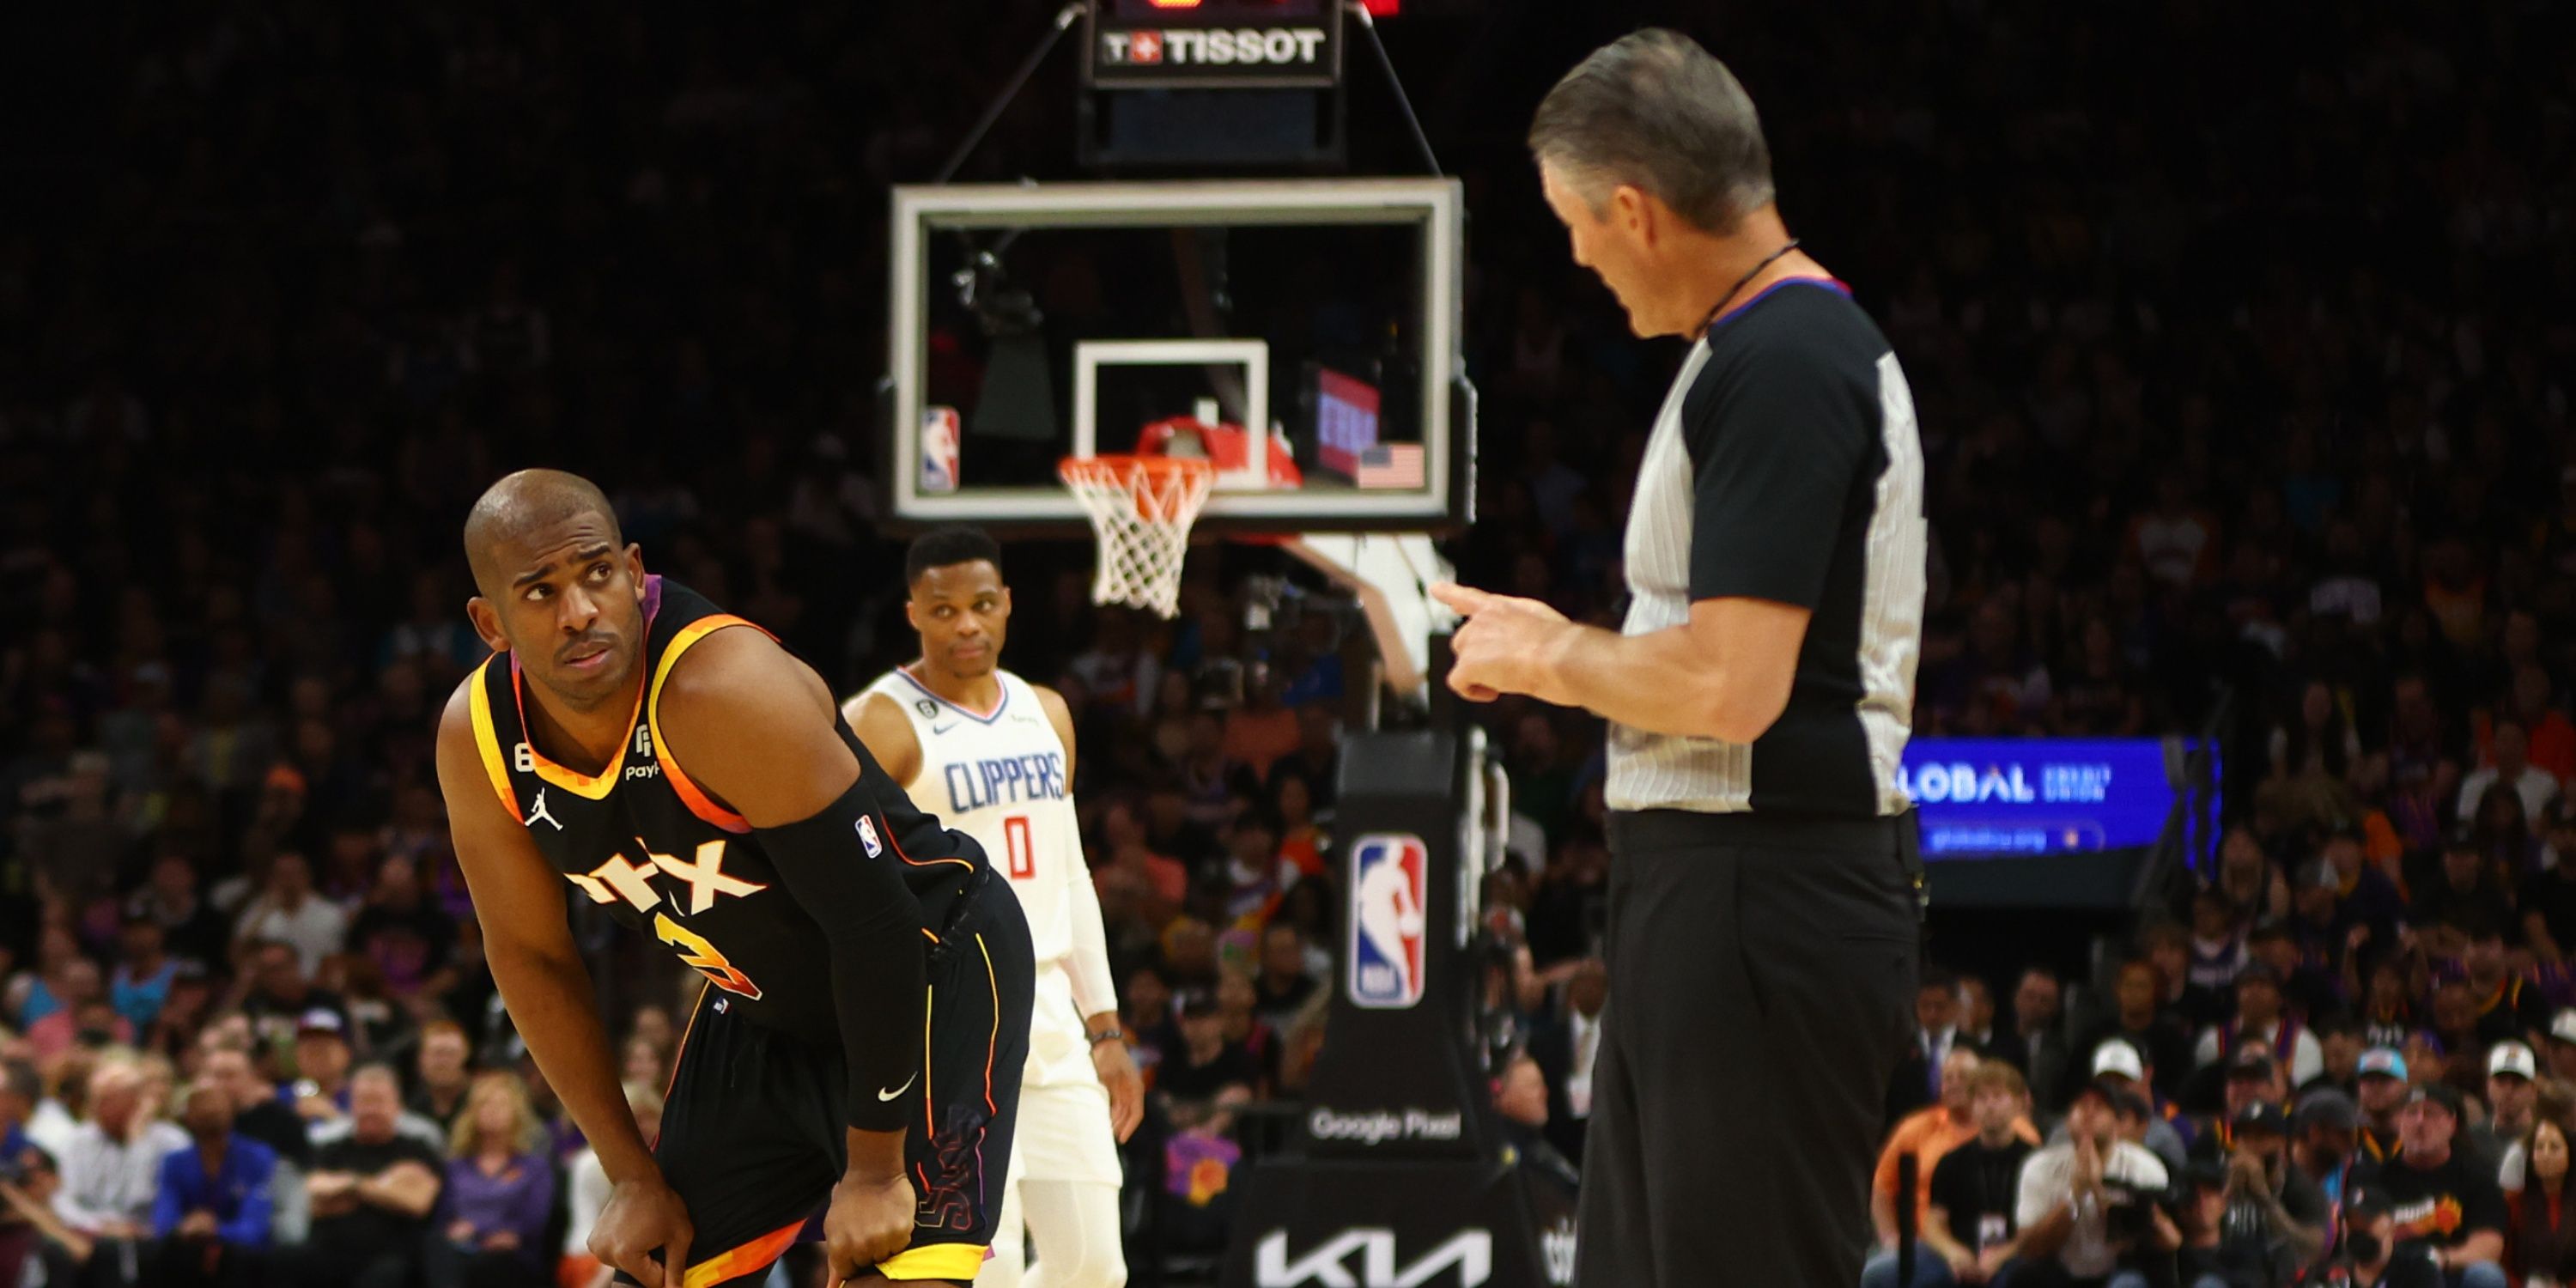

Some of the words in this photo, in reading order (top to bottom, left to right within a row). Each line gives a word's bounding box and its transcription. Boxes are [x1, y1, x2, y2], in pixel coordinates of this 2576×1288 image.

[1164, 29, 1326, 64] TISSOT
[944, 751, 1065, 815] CLIPPERS
[1895, 762, 2035, 803] LOBAL
[1310, 1107, 1403, 1145] Google
[1406, 1107, 1461, 1140] Pixel
